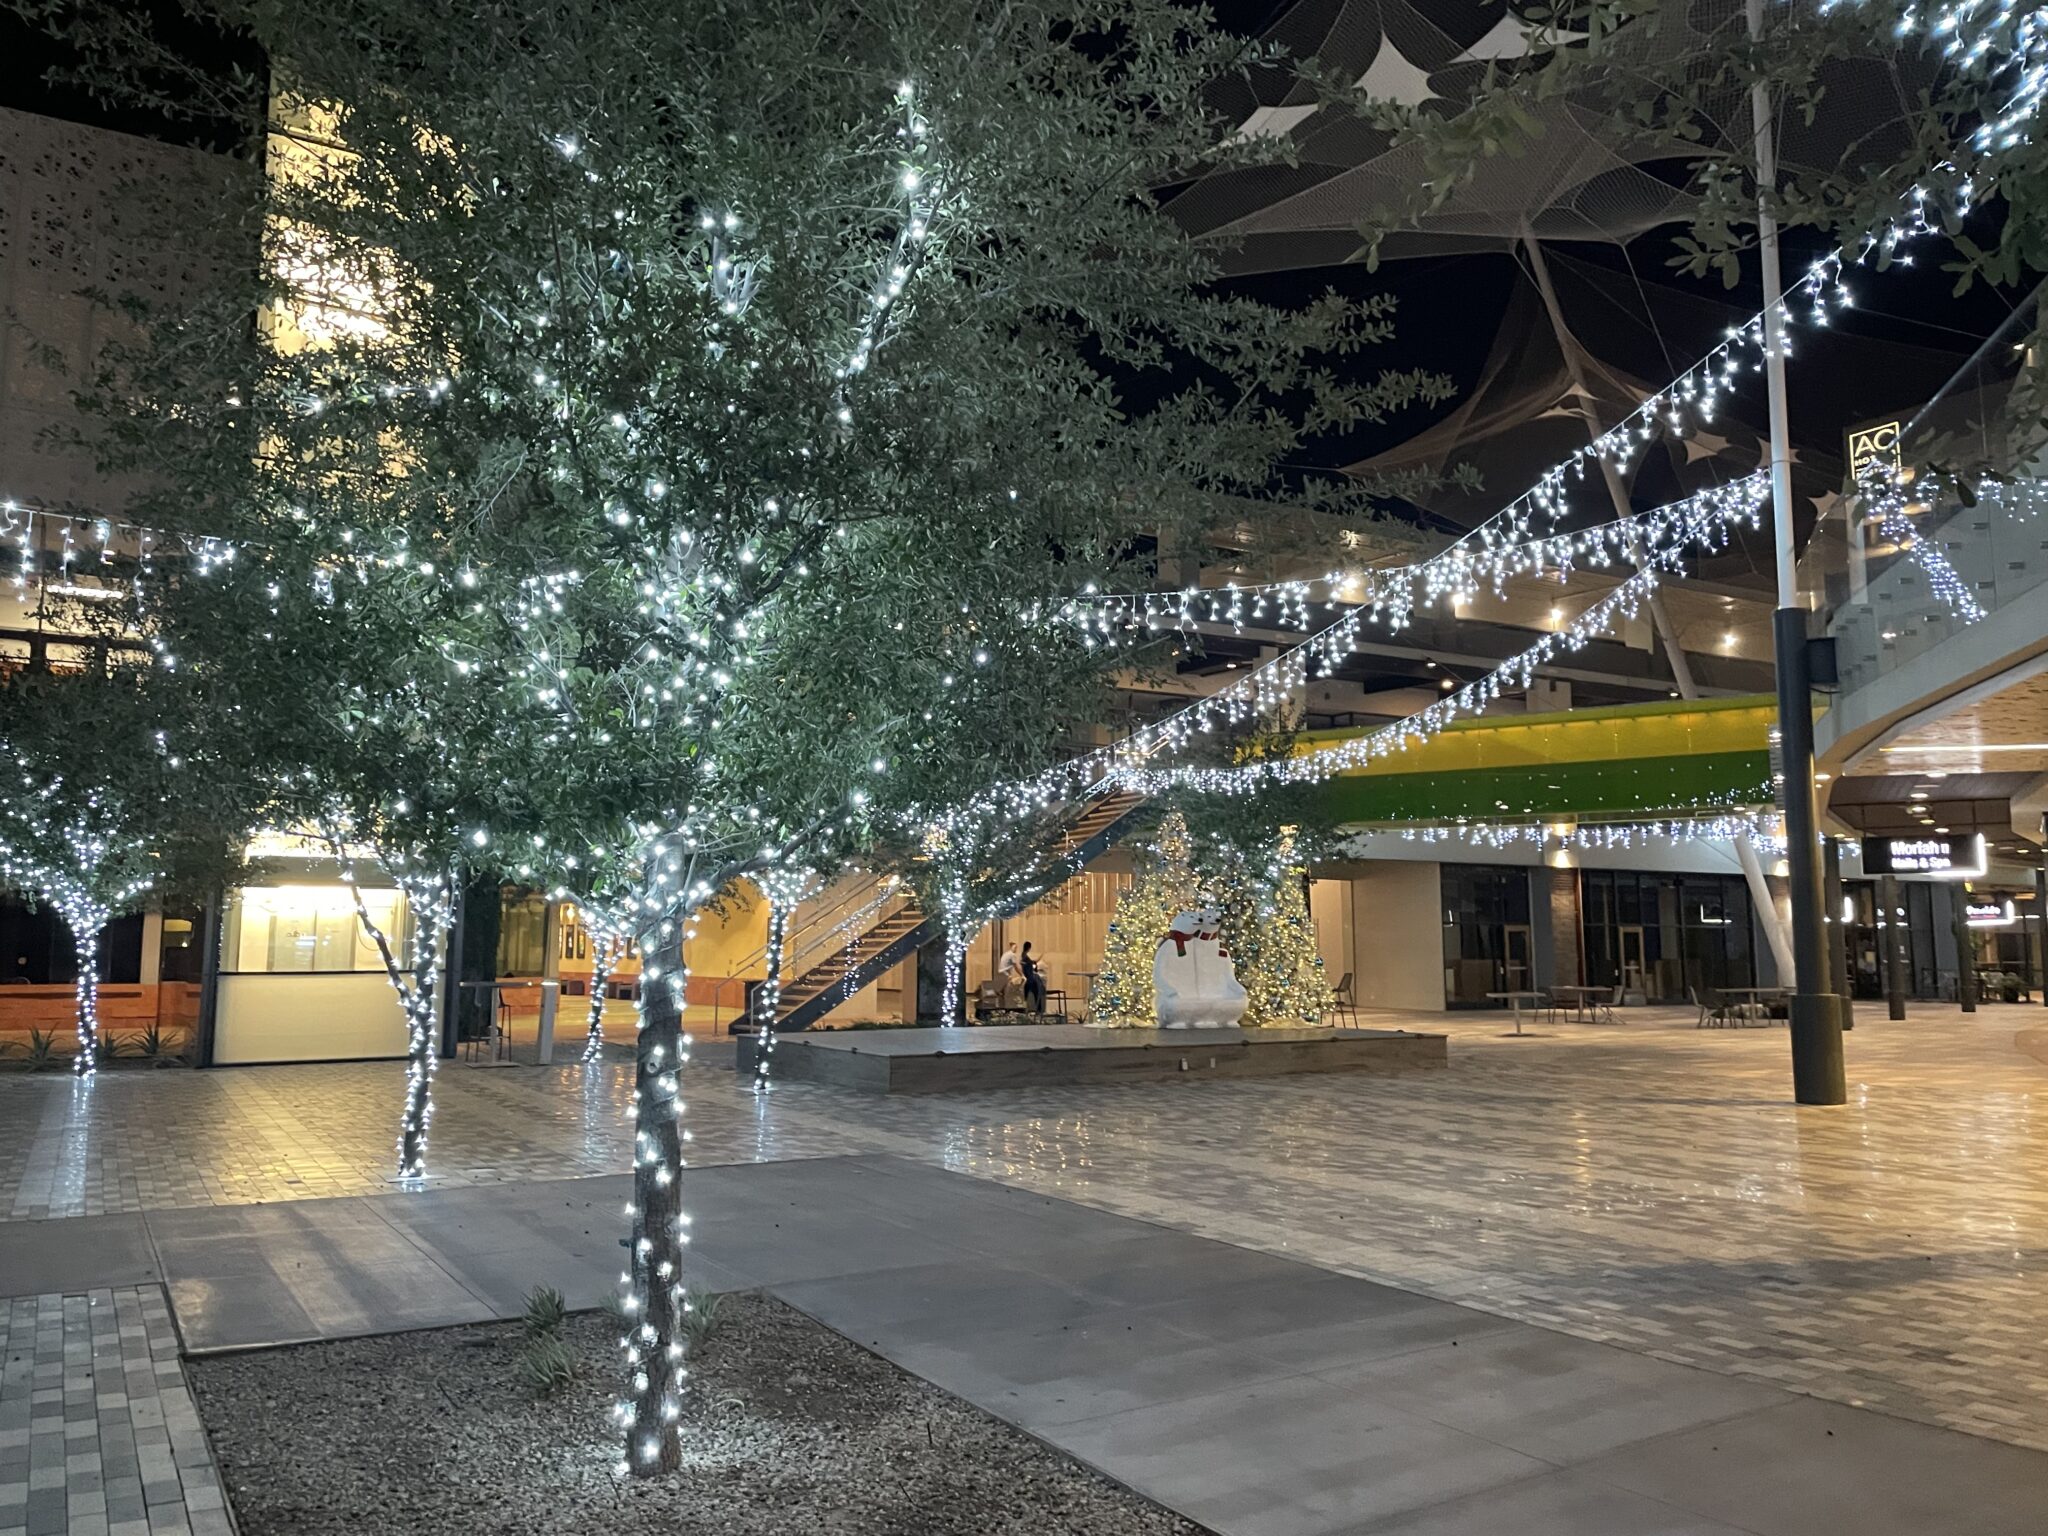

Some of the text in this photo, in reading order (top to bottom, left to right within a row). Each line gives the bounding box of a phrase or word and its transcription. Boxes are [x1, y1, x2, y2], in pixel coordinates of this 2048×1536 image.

[1855, 428, 1895, 457] AC
[1919, 857, 1929, 869] &
[1929, 857, 1951, 869] Spa
